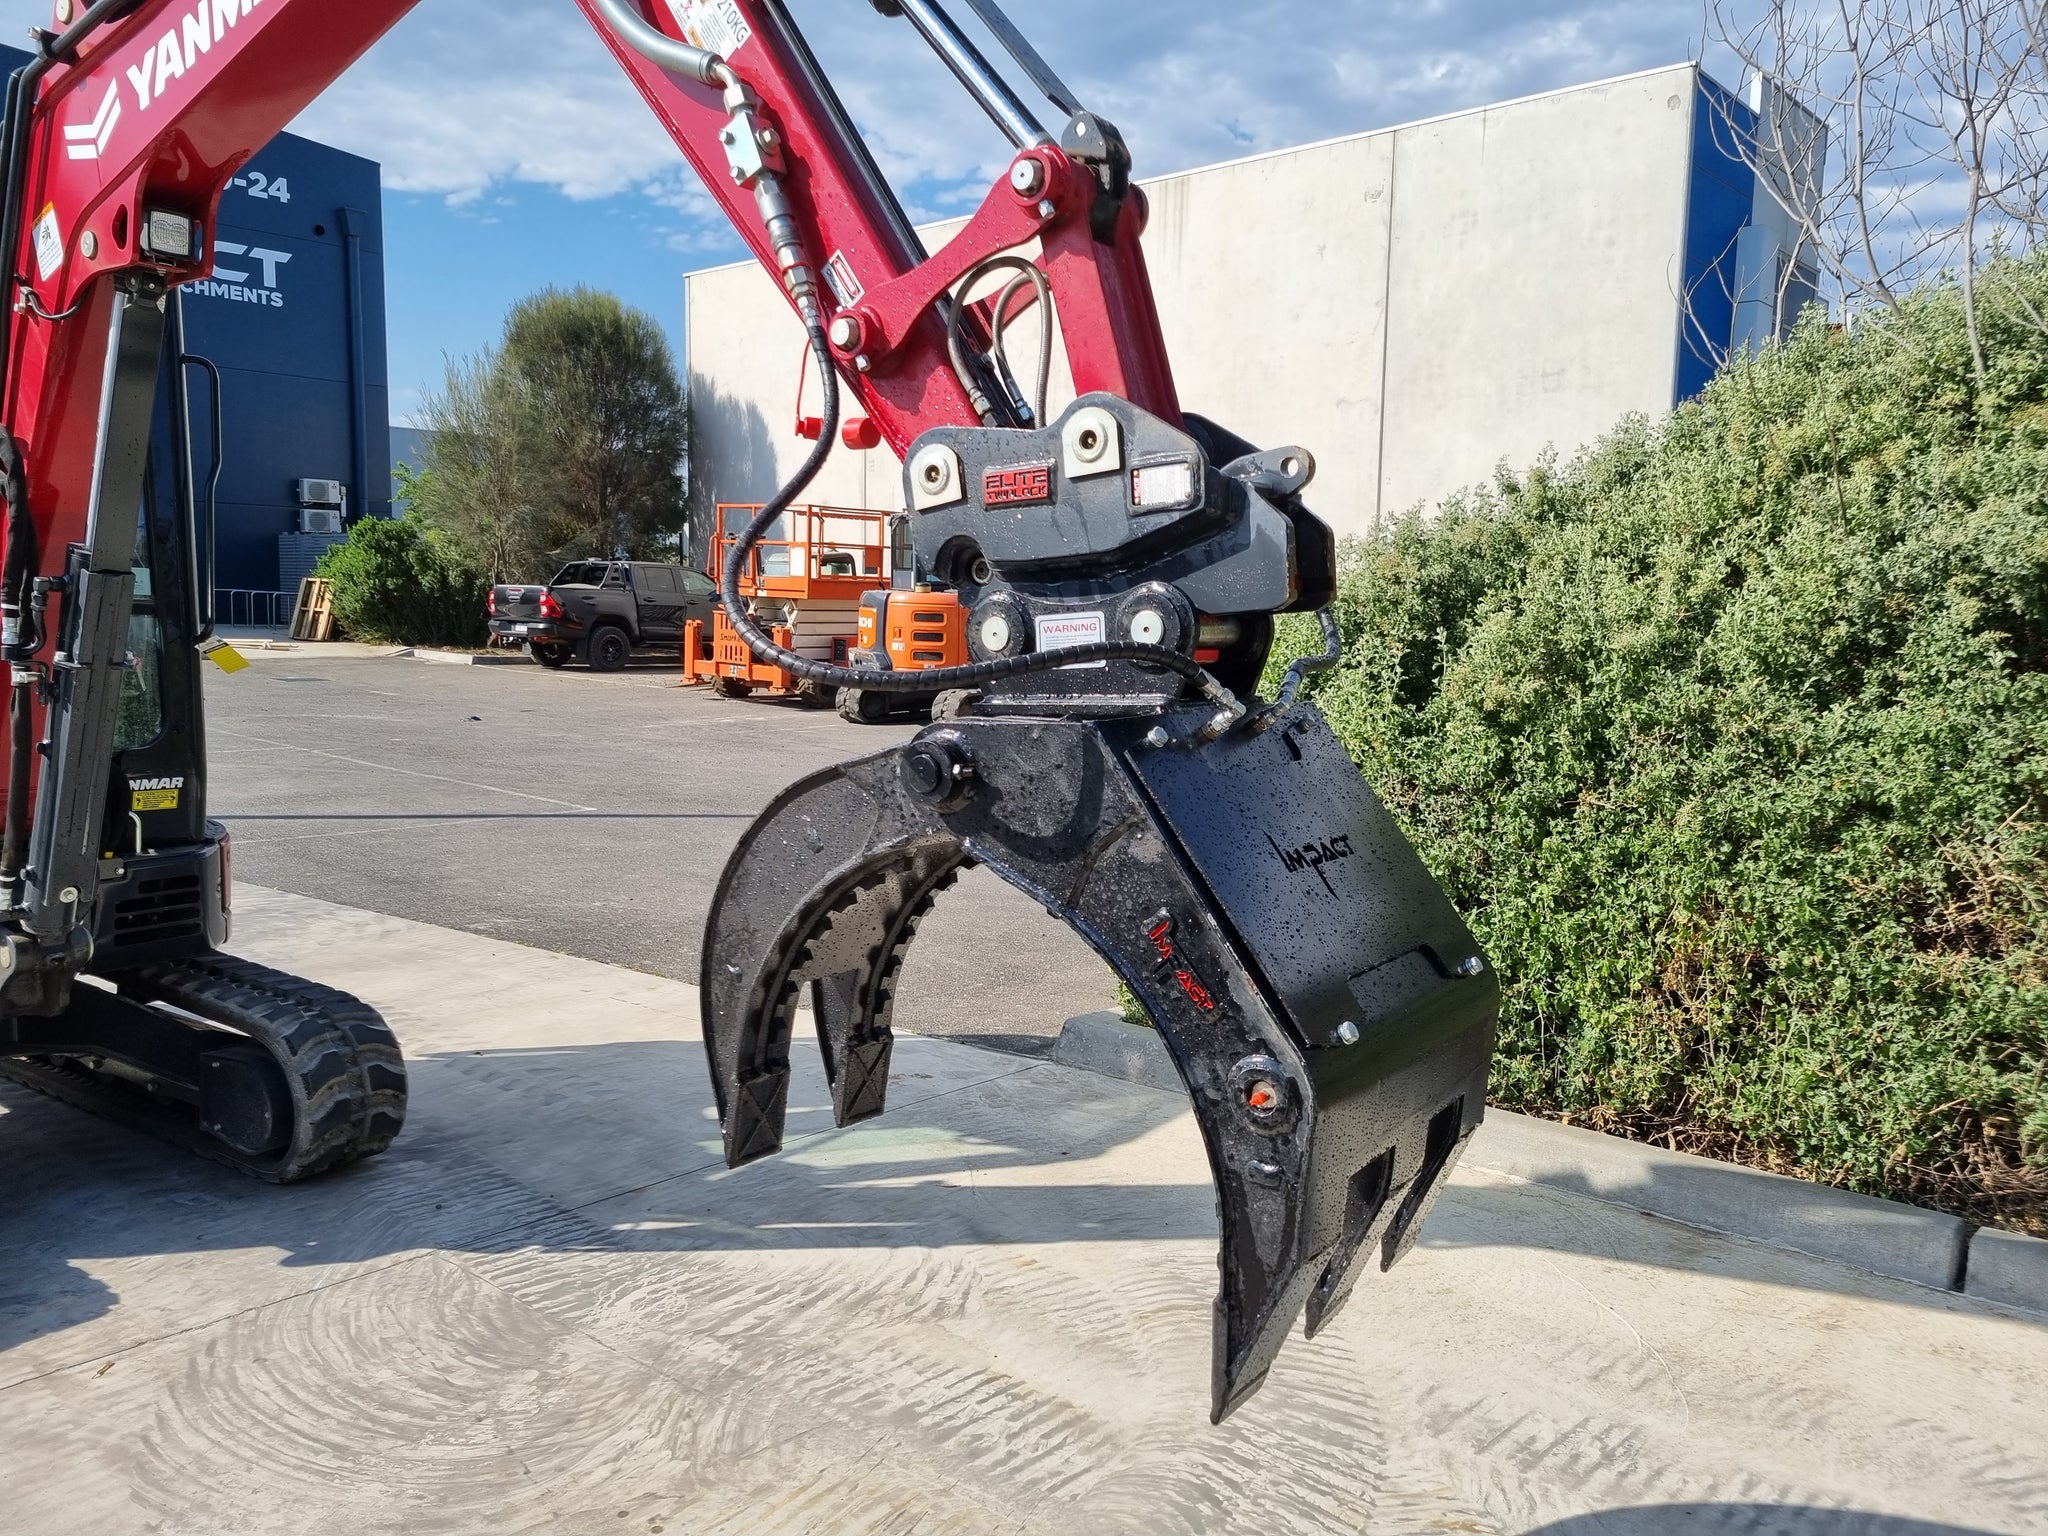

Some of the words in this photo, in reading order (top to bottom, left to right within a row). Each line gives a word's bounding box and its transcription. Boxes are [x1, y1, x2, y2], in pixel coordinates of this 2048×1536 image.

[126, 0, 263, 111] YANM
[223, 171, 291, 203] -24
[986, 469, 1047, 489] ELITE
[986, 485, 1046, 500] TWINLOCK
[1043, 622, 1097, 634] WARNING
